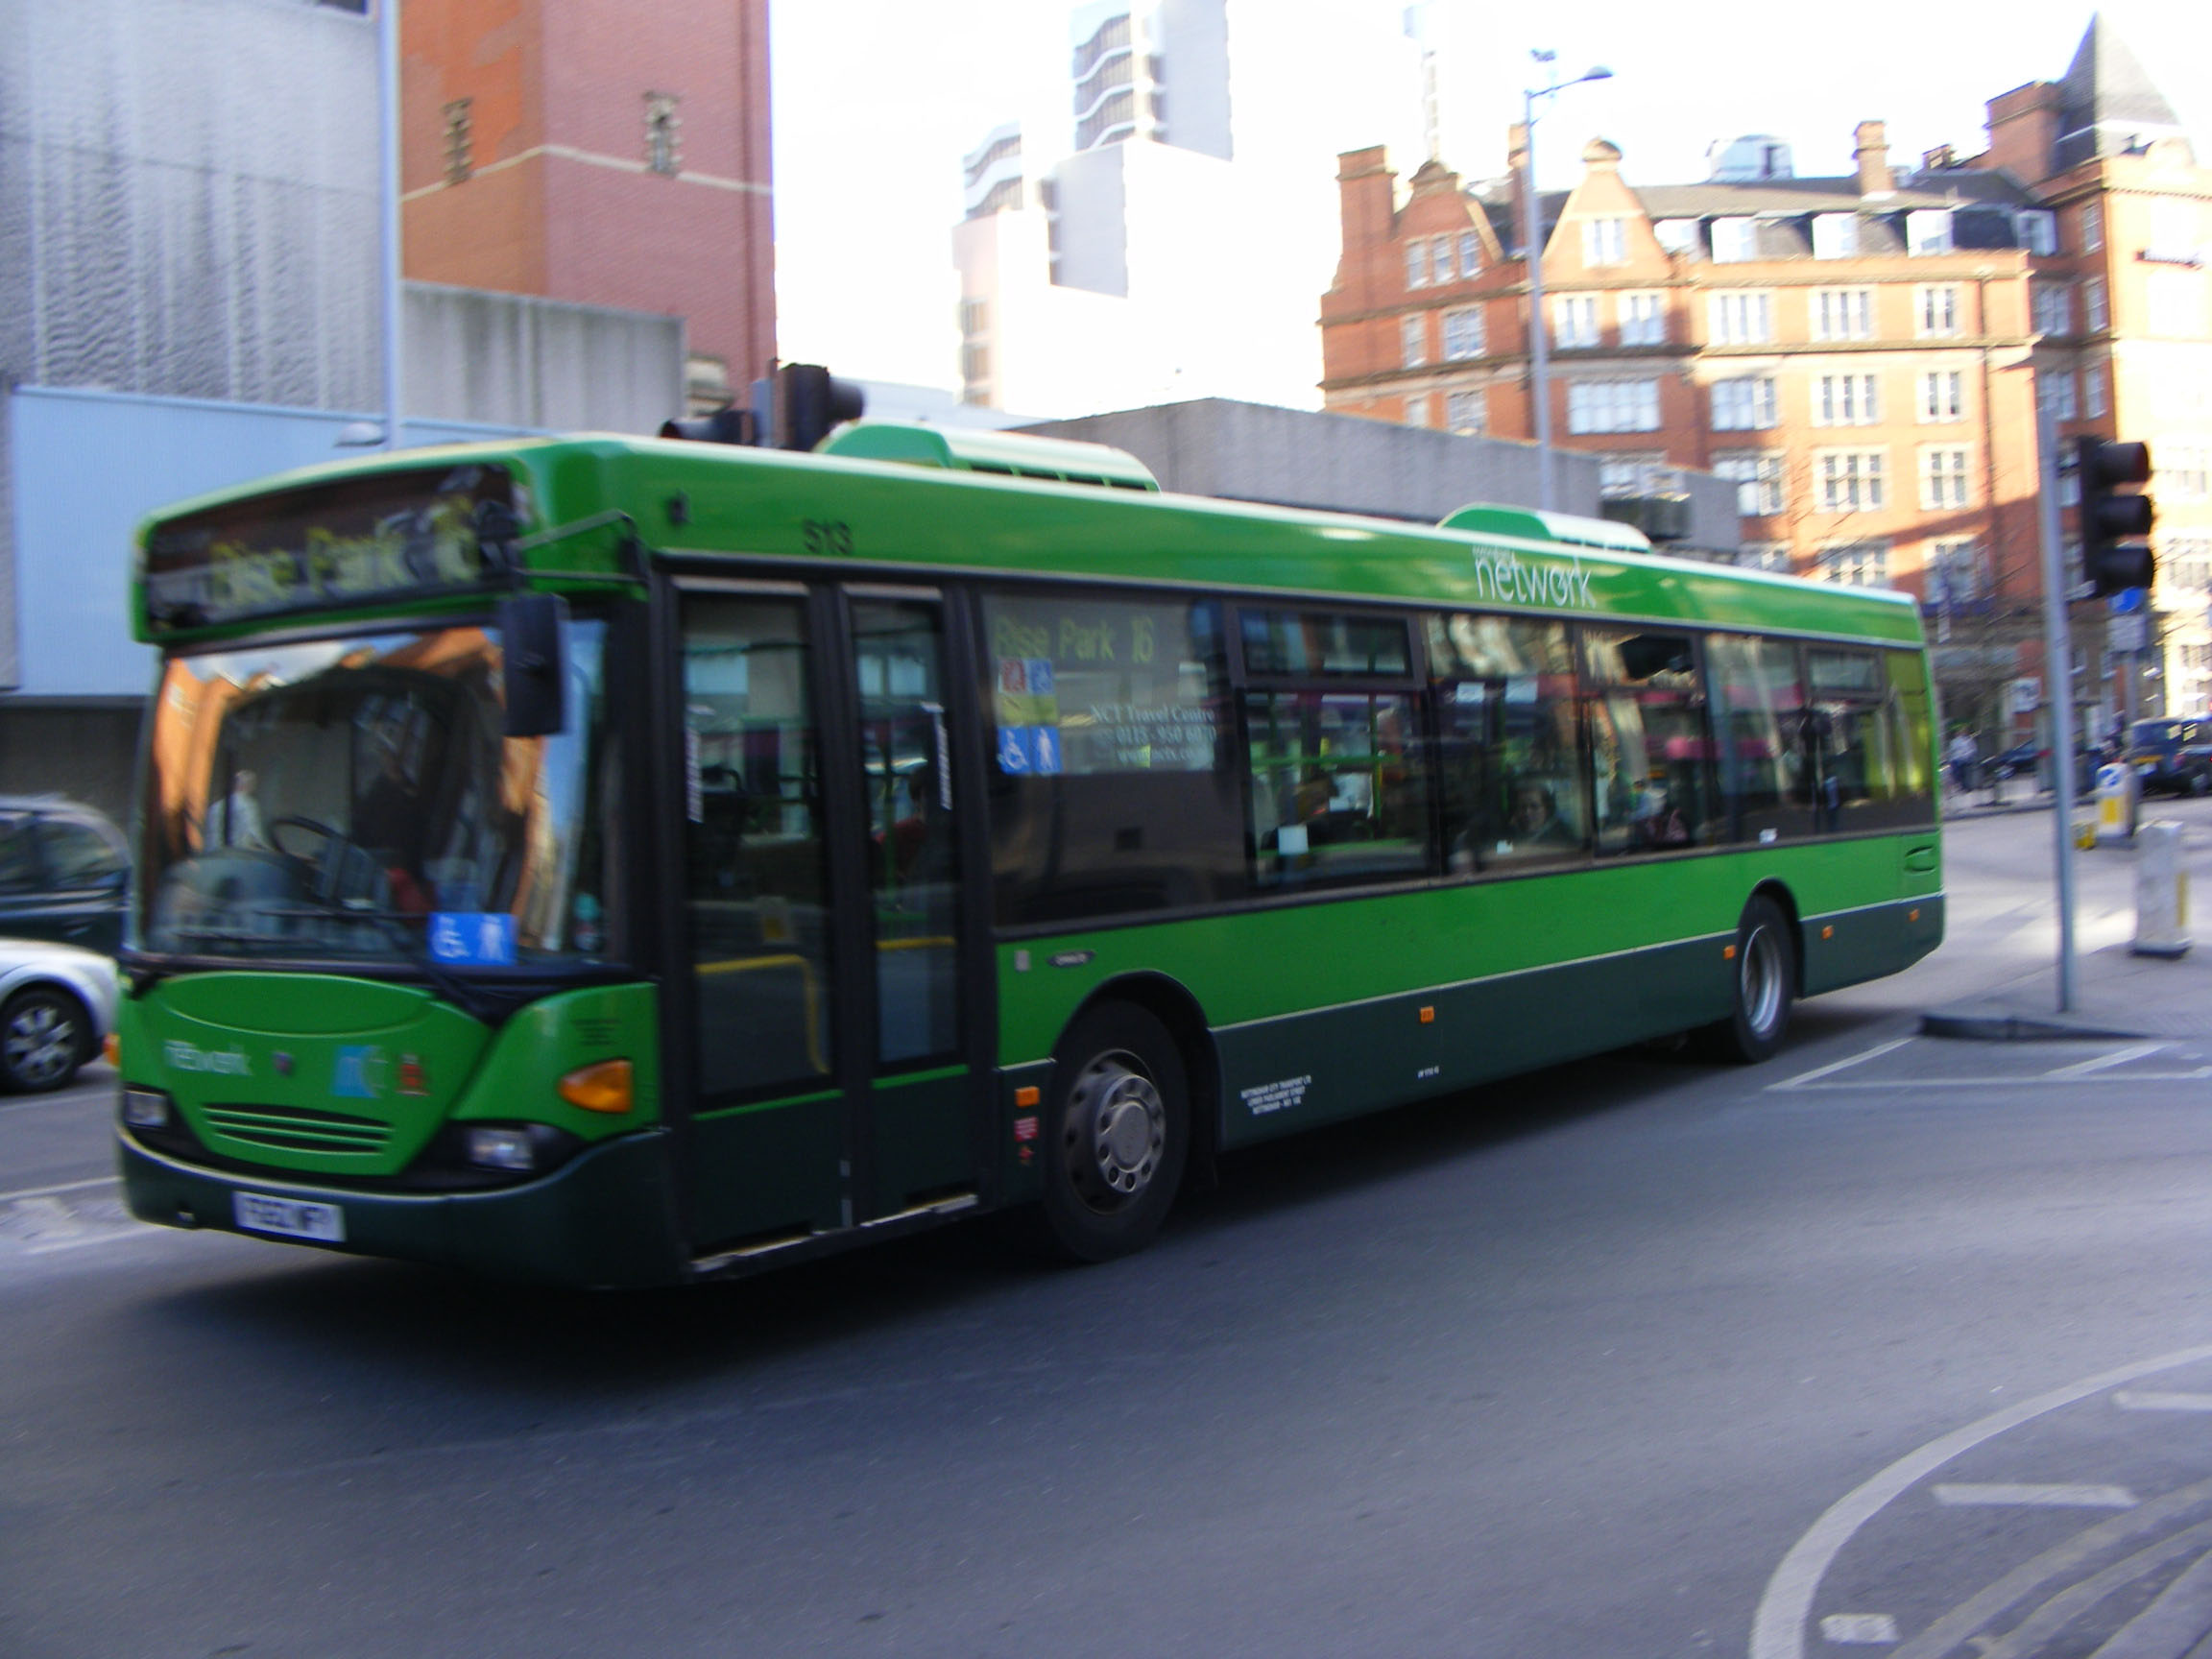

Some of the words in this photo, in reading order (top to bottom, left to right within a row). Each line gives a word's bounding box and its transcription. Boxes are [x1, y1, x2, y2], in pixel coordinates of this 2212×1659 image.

[1475, 551, 1597, 609] network
[995, 614, 1049, 659] Rise
[1059, 616, 1115, 661] Park
[1130, 615, 1153, 662] 16
[1091, 703, 1121, 724] NCT
[1126, 703, 1168, 724] Travel
